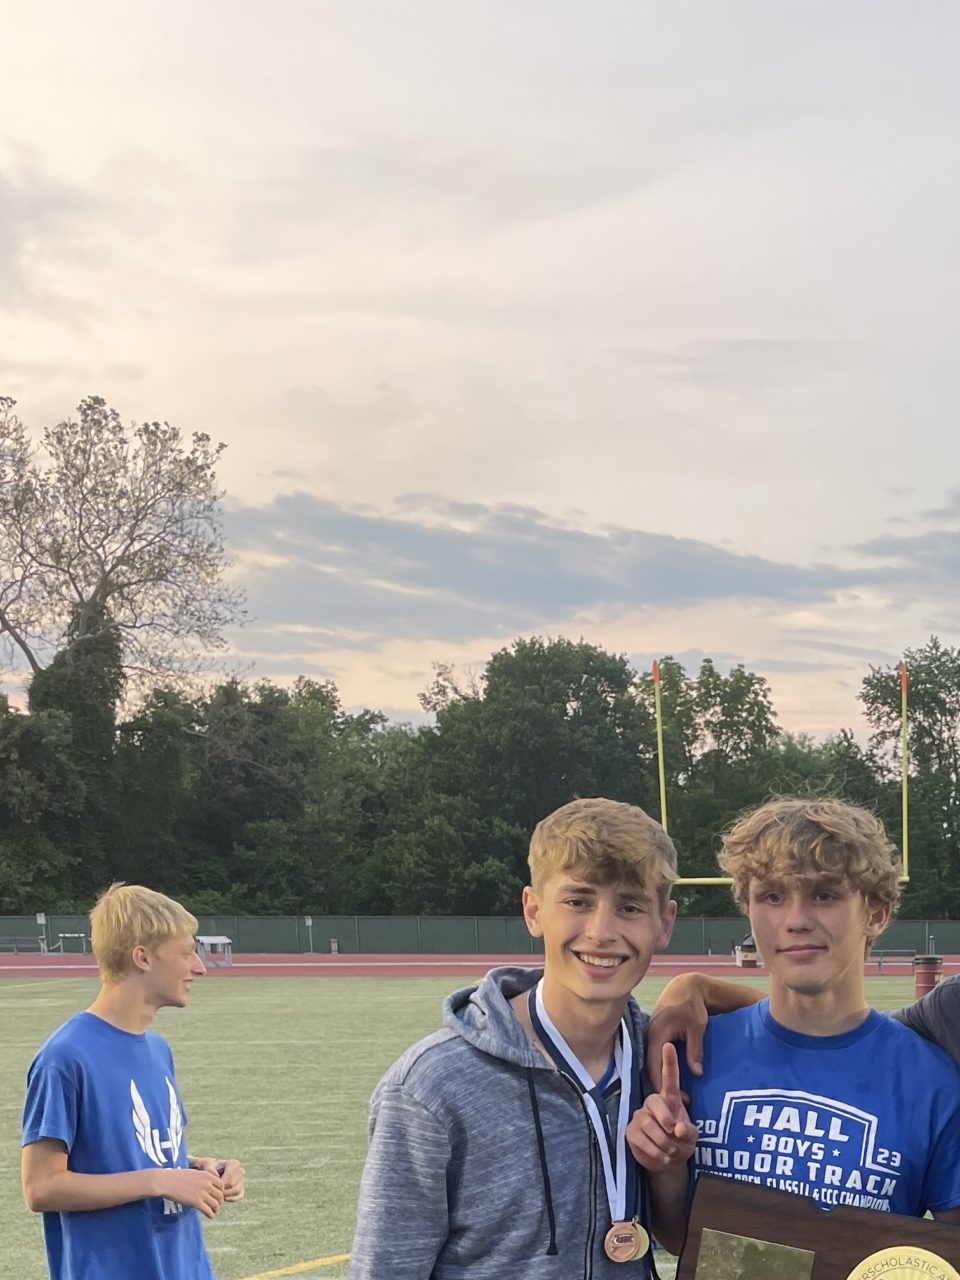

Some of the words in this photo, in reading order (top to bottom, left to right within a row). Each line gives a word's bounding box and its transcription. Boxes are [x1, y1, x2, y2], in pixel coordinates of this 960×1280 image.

[696, 1119, 717, 1134] 20
[743, 1104, 850, 1142] HALL
[760, 1133, 826, 1160] BOYS
[876, 1148, 902, 1167] 23
[695, 1146, 795, 1176] INDOOR
[806, 1161, 897, 1197] TRACK
[812, 1187, 821, 1201] &
[821, 1187, 839, 1205] CCC
